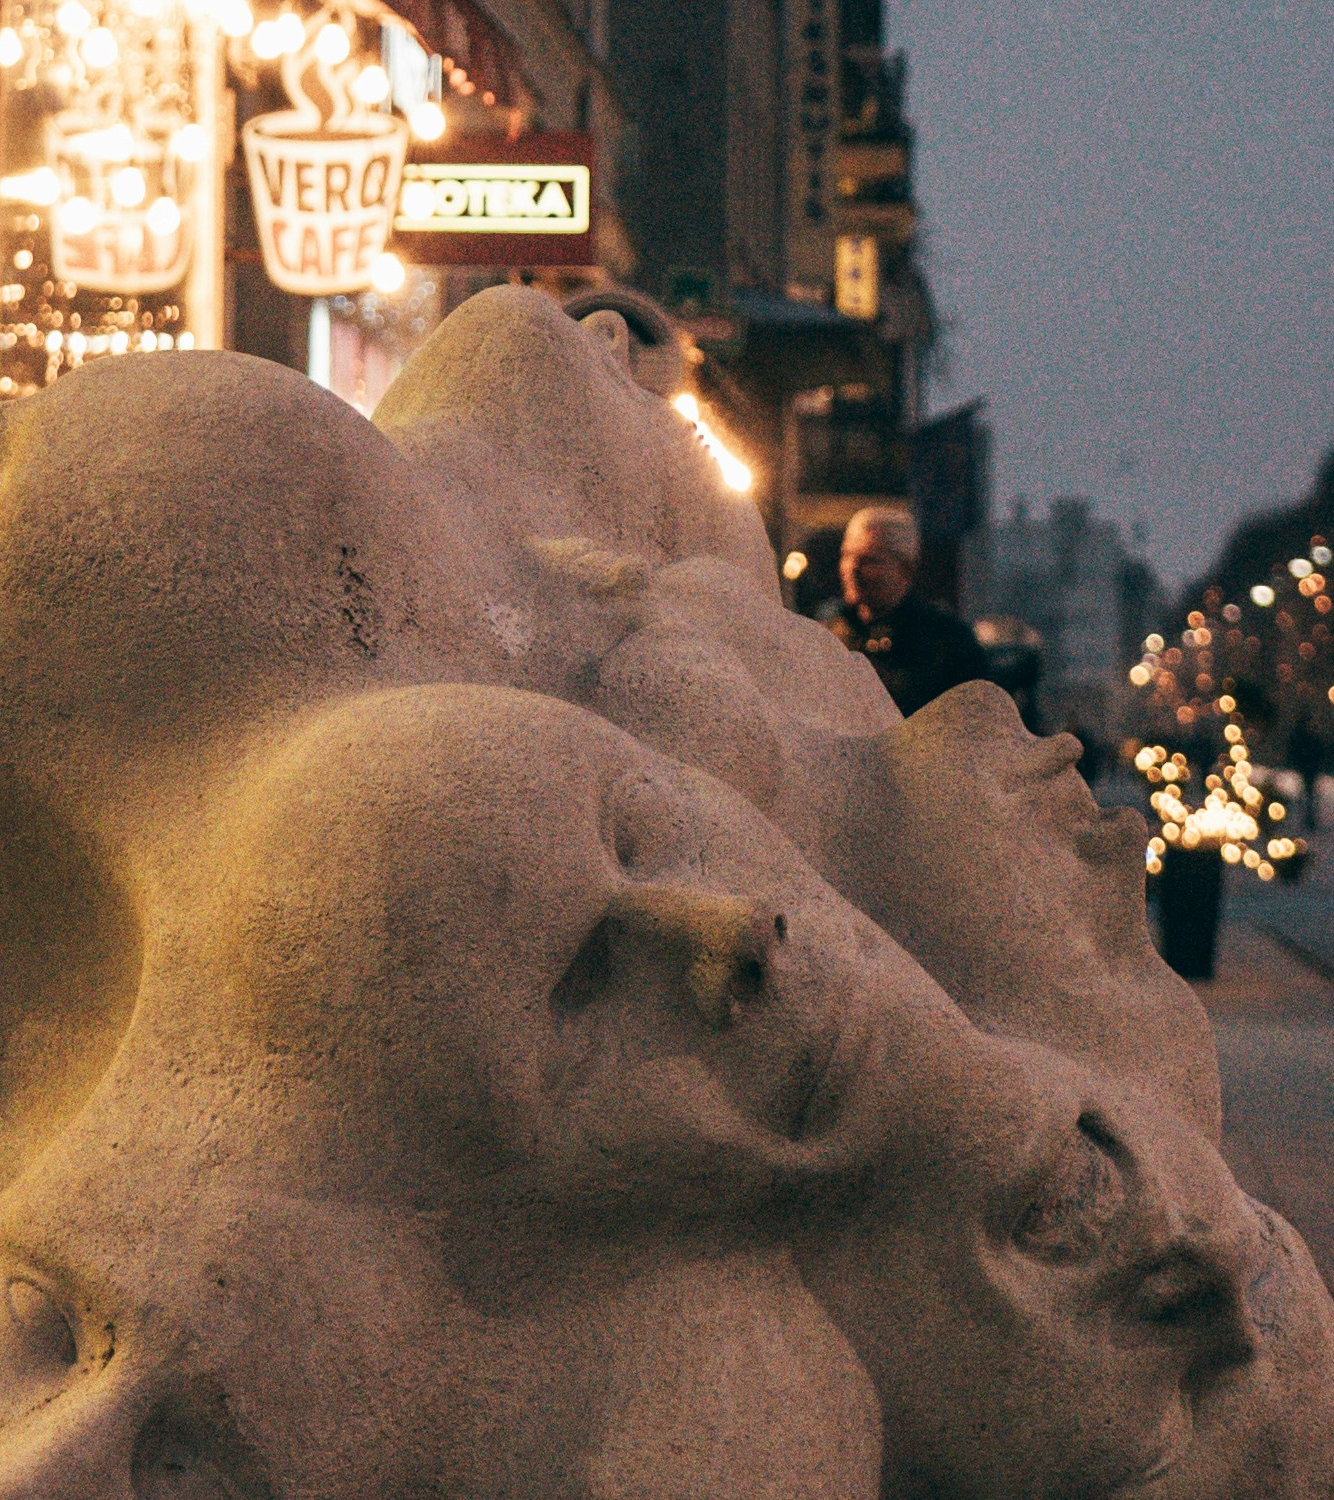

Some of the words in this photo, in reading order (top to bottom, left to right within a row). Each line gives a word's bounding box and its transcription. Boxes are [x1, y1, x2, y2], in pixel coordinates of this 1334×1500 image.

[258, 152, 390, 213] VERO
[402, 179, 572, 217] OTEKA
[272, 221, 383, 277] CAFE
